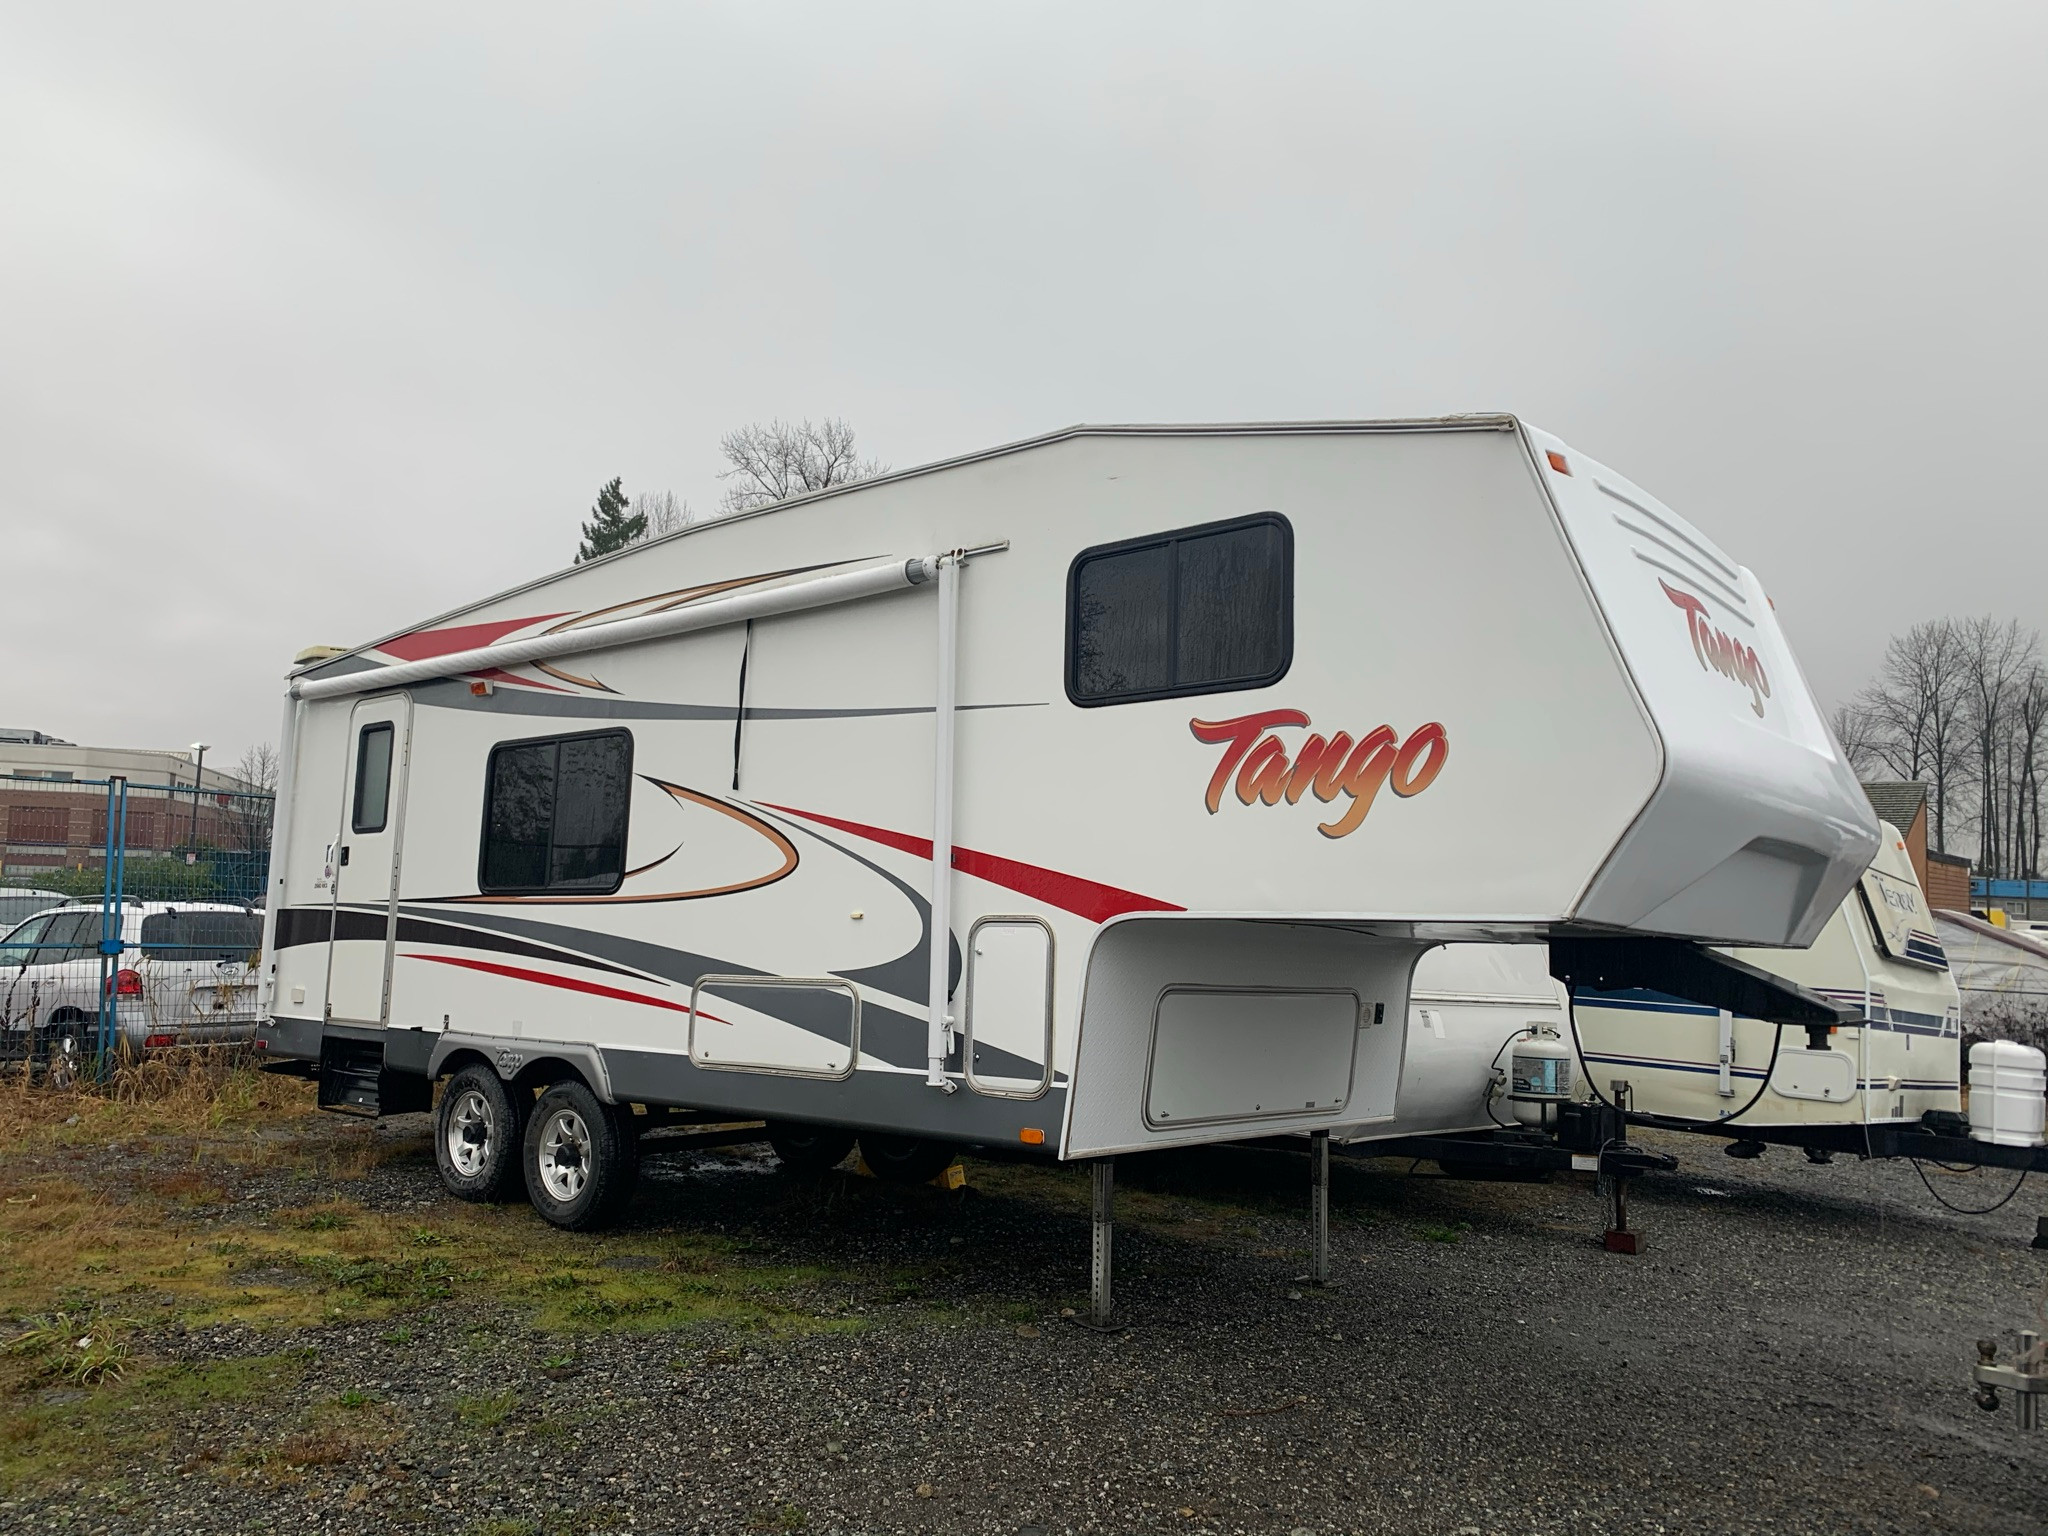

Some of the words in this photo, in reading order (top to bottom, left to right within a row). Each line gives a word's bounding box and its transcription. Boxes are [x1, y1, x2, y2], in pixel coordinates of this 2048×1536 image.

[1658, 576, 1771, 719] Tango
[1189, 708, 1449, 839] Tango
[495, 1046, 523, 1075] Tango
